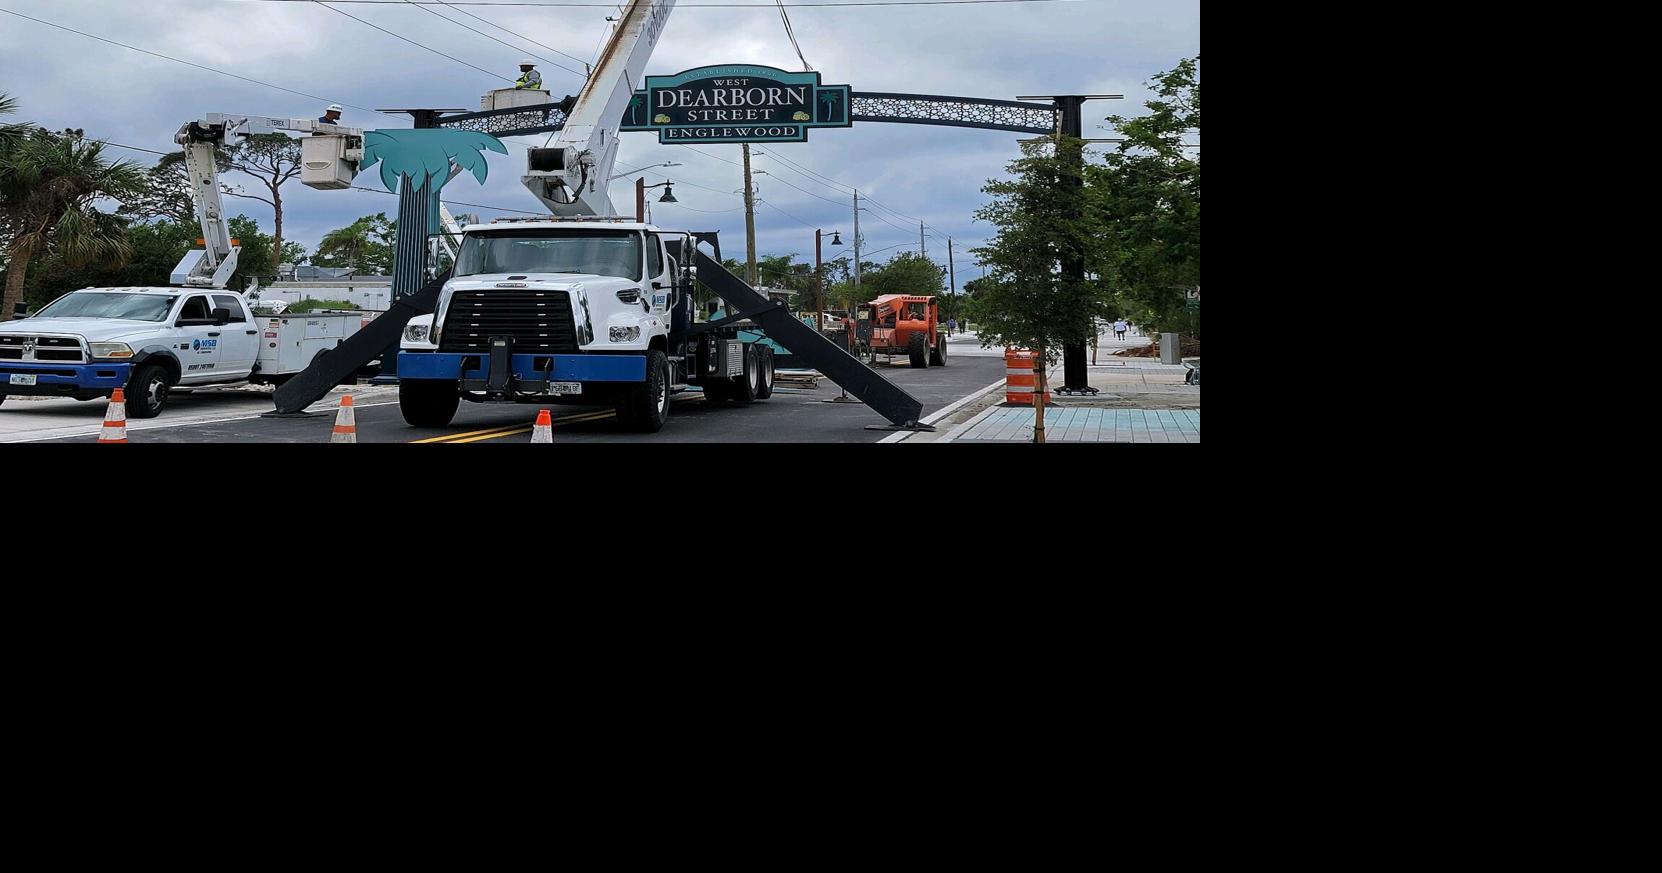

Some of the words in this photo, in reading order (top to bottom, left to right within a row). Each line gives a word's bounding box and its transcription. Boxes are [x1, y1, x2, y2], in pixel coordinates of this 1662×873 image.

[713, 78, 749, 86] WEST
[657, 87, 806, 108] DEARBORN
[687, 109, 775, 121] STREET
[668, 127, 796, 138] ENGLEWOOD
[201, 339, 217, 347] MSB
